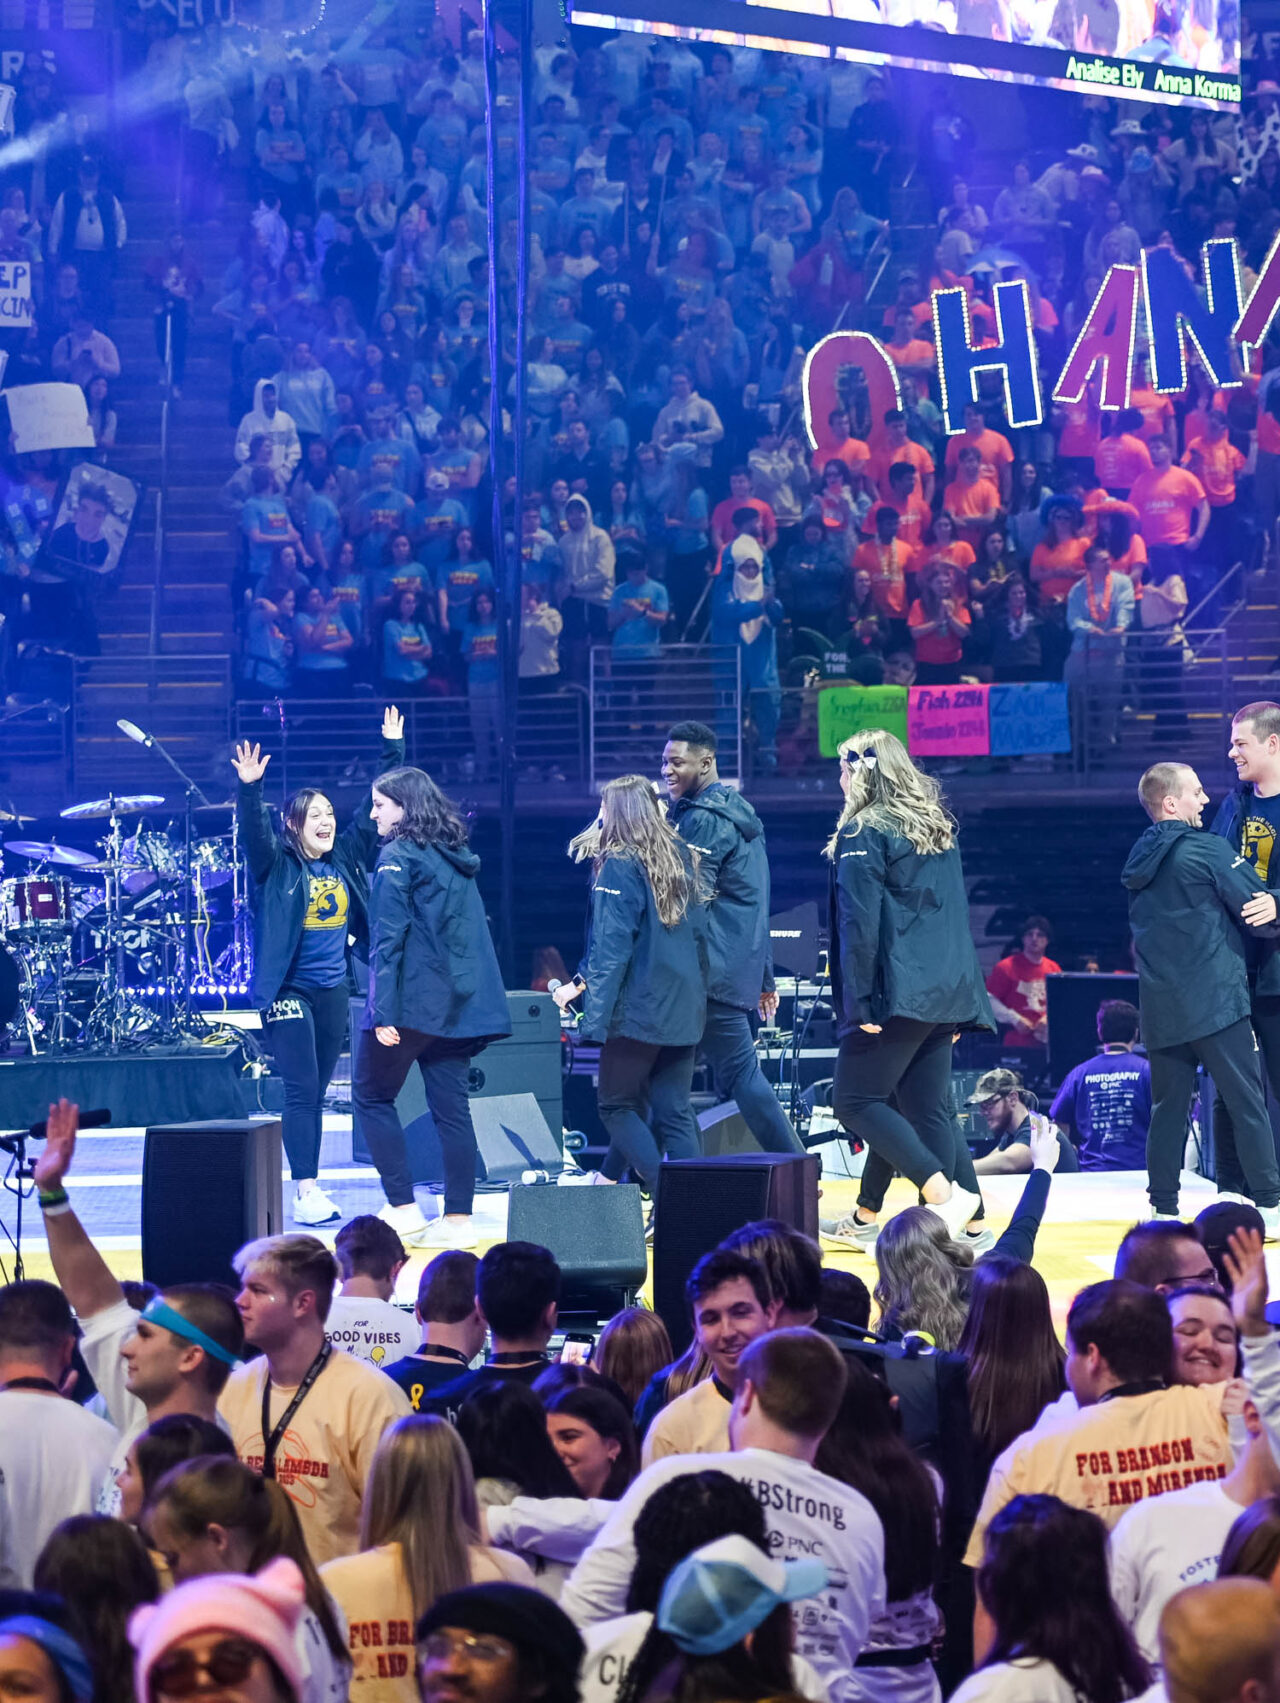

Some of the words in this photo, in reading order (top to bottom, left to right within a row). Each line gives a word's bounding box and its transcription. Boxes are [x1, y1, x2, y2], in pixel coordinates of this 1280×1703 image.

[1066, 56, 1121, 85] Analise
[1122, 64, 1145, 90] Ely
[1154, 69, 1193, 95] Anna
[1195, 75, 1242, 102] Korma
[769, 929, 802, 938] SHURE
[269, 999, 301, 1014] HON
[1085, 1071, 1141, 1084] PHOTOGRAPHY
[325, 1330, 361, 1344] GOOD
[364, 1332, 402, 1345] VIBES
[1076, 1451, 1114, 1477] FOR
[1116, 1437, 1195, 1475] BRANSON
[1108, 1478, 1144, 1507] AND
[1147, 1463, 1227, 1499] MIRANDA
[788, 1536, 824, 1557] PNC
[349, 1621, 383, 1650] FOR
